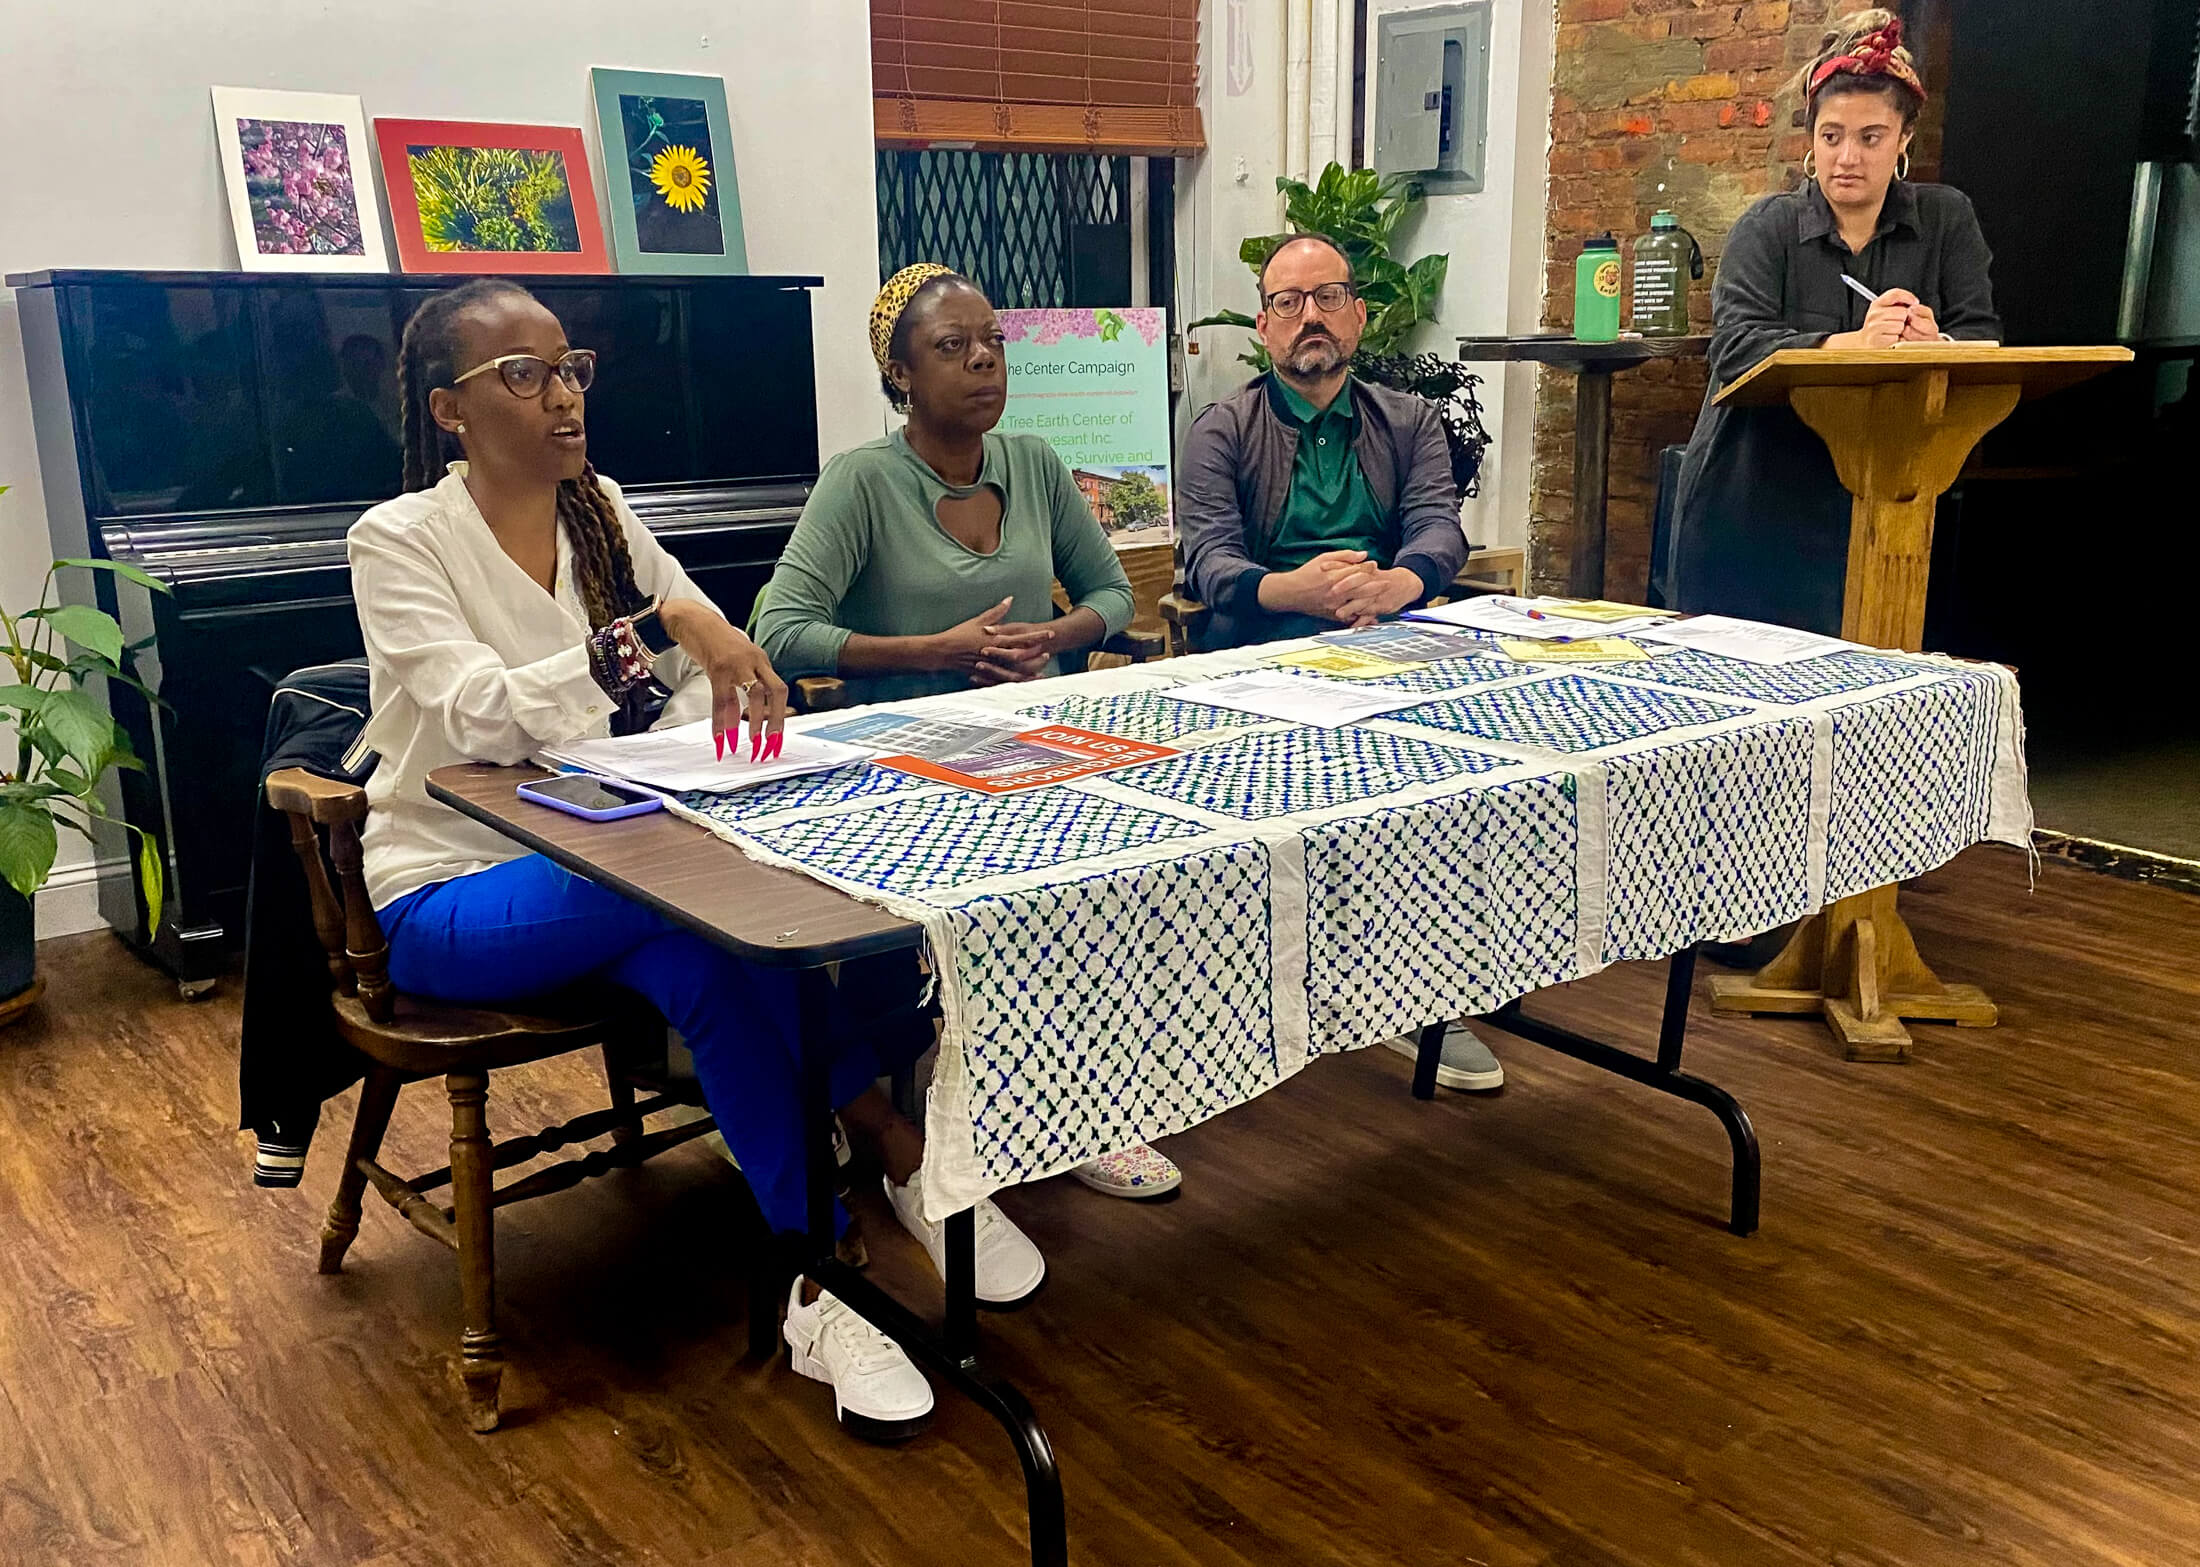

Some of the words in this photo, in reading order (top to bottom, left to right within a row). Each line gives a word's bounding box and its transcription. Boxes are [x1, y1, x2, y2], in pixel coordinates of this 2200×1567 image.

[1007, 362, 1022, 376] he
[1025, 361, 1064, 375] Center
[1068, 360, 1135, 376] Campaign
[1008, 416, 1033, 429] Tree
[1036, 415, 1069, 428] Earth
[1072, 413, 1115, 426] Center
[1120, 412, 1134, 425] of
[1047, 432, 1087, 447] vesant
[1075, 451, 1124, 464] Survive
[1127, 450, 1153, 462] and
[1030, 730, 1088, 745] JOIN
[1088, 738, 1130, 753] US
[986, 748, 1158, 788] NEIGHBORS
